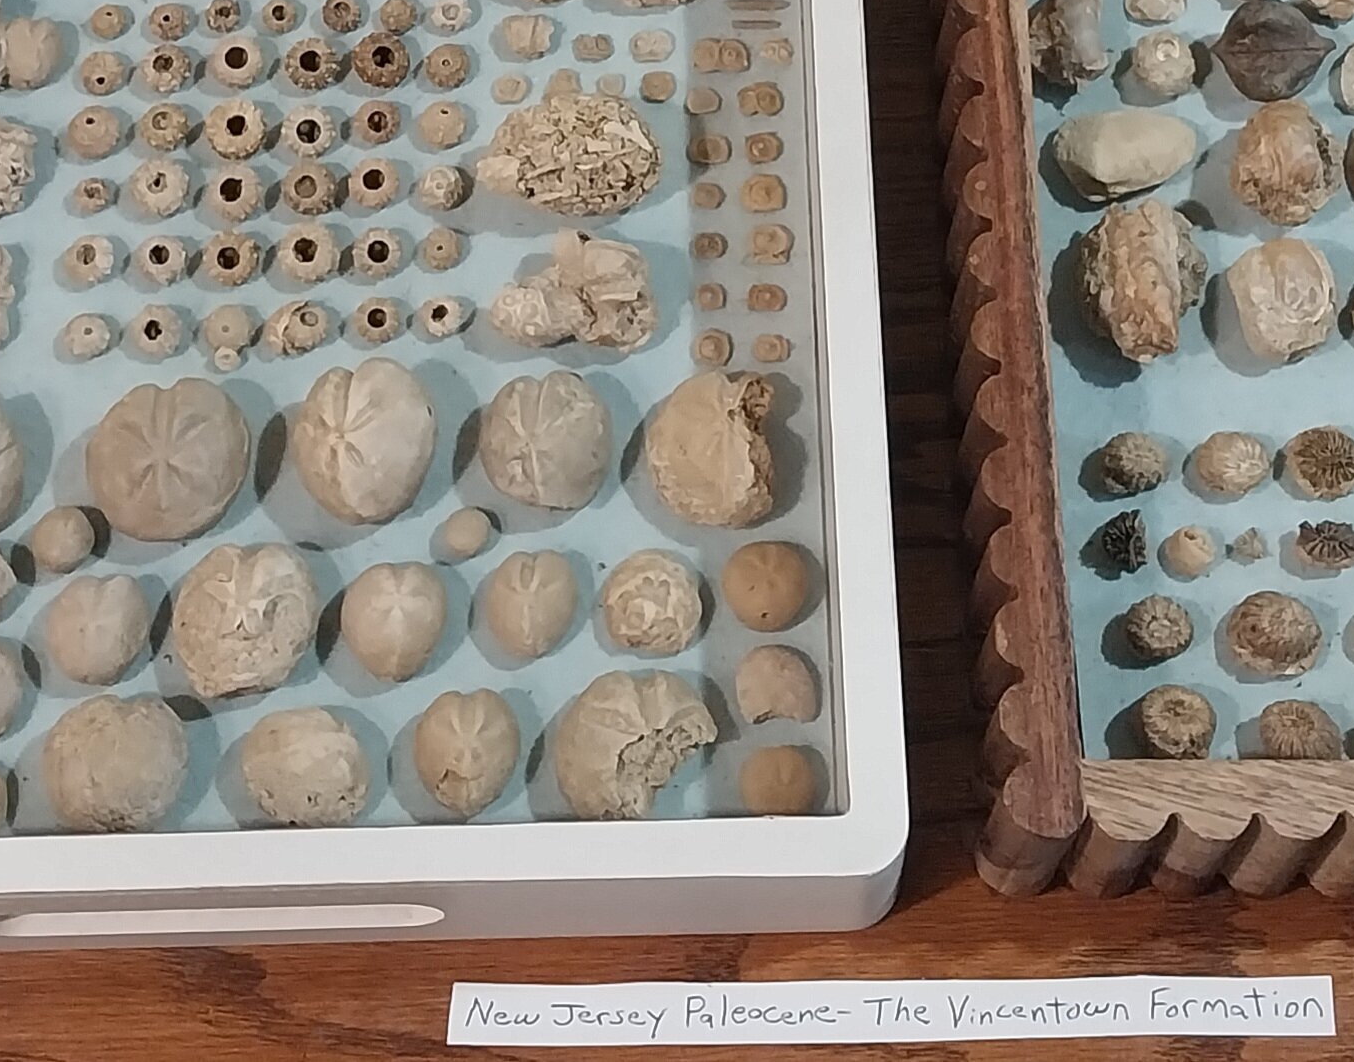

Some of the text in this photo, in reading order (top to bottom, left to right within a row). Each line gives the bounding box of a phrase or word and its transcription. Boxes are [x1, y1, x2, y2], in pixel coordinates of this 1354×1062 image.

[466, 998, 541, 1026] New
[551, 1004, 667, 1039] Jersey
[863, 997, 931, 1026] The
[948, 995, 1130, 1028] Vincentown
[1151, 987, 1324, 1020] Formation
